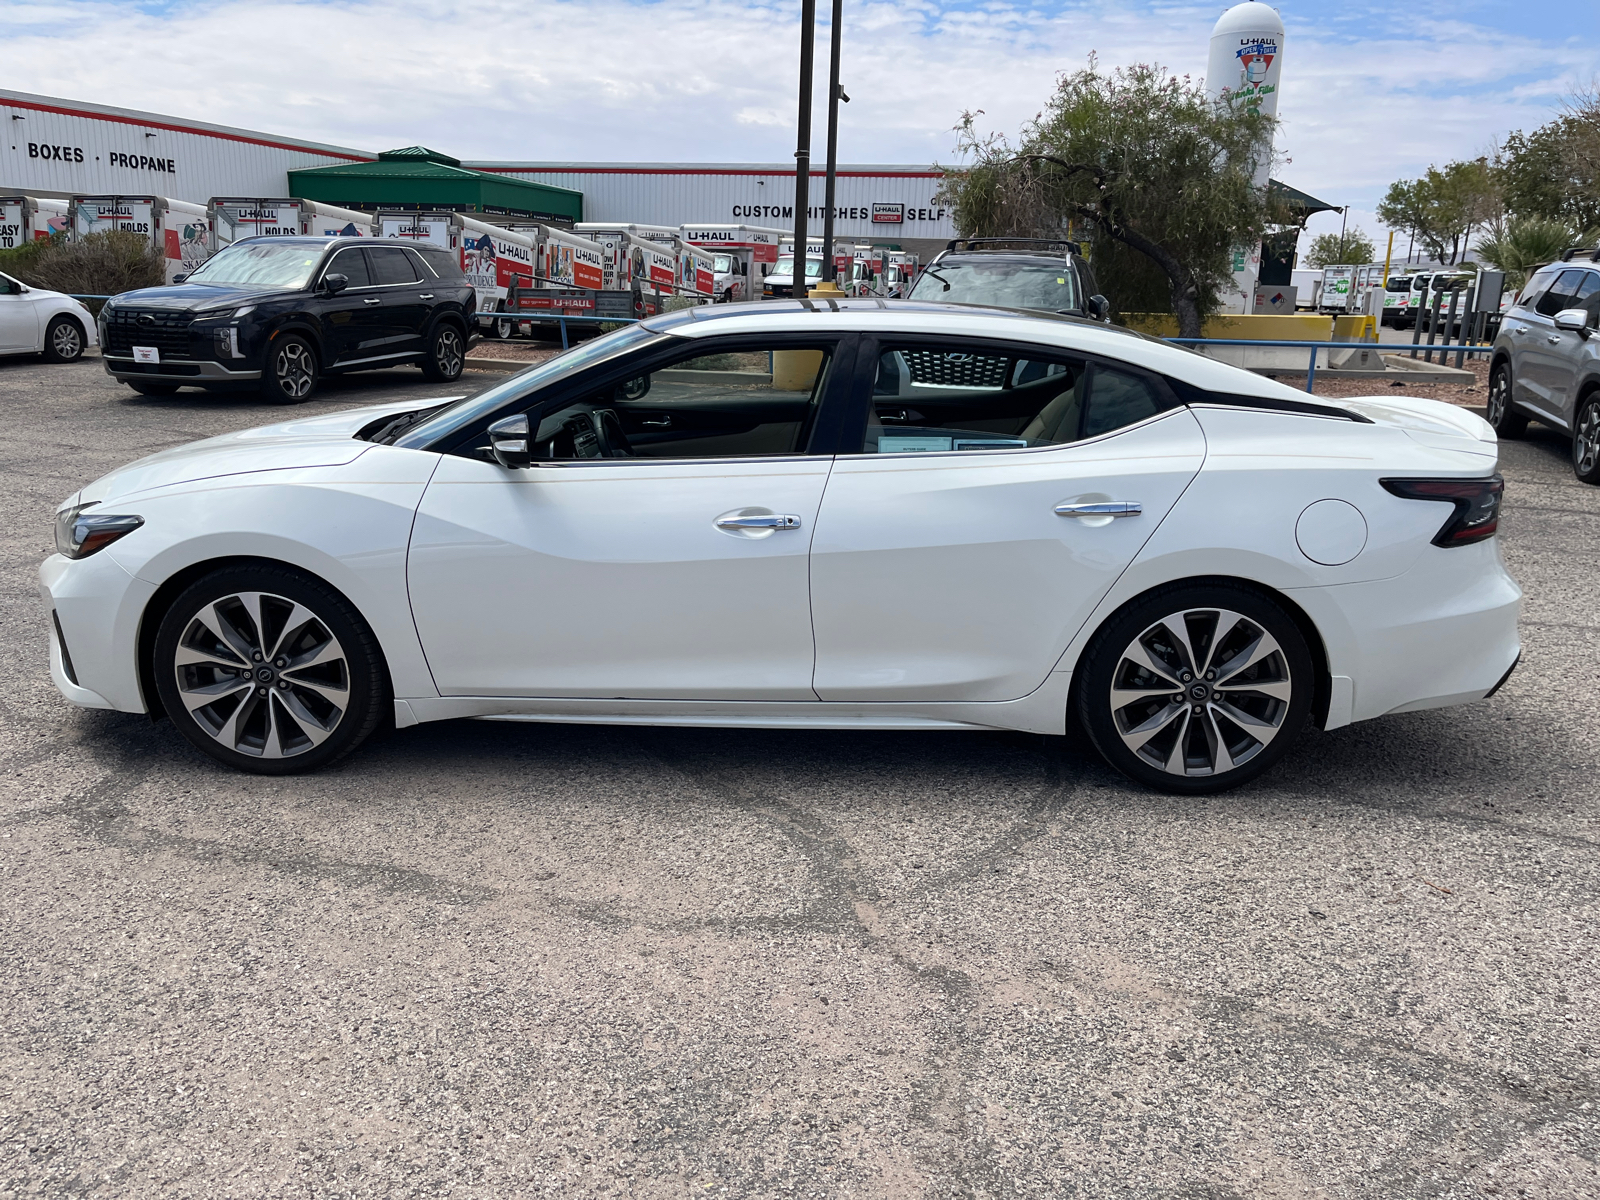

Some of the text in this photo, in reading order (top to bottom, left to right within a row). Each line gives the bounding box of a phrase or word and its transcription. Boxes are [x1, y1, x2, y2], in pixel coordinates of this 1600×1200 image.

[1241, 46, 1258, 55] OPEN
[28, 142, 84, 163] BOXES
[110, 151, 176, 173] PROPANE
[98, 206, 132, 215] U-HAUL
[238, 209, 277, 219] U-HAUL
[732, 205, 793, 218] CUSTOM
[907, 208, 946, 221] SELF
[120, 222, 149, 233] HOLDS
[399, 226, 430, 234] U-HAUL
[2, 236, 14, 248] TO
[688, 231, 734, 241] U-HAUL
[498, 242, 530, 262] U-HAUL
[575, 248, 601, 266] U-HAUL
[653, 253, 674, 270] U-HAUL
[697, 257, 713, 272] U-HAUL
[553, 298, 592, 308] U-HAUL
